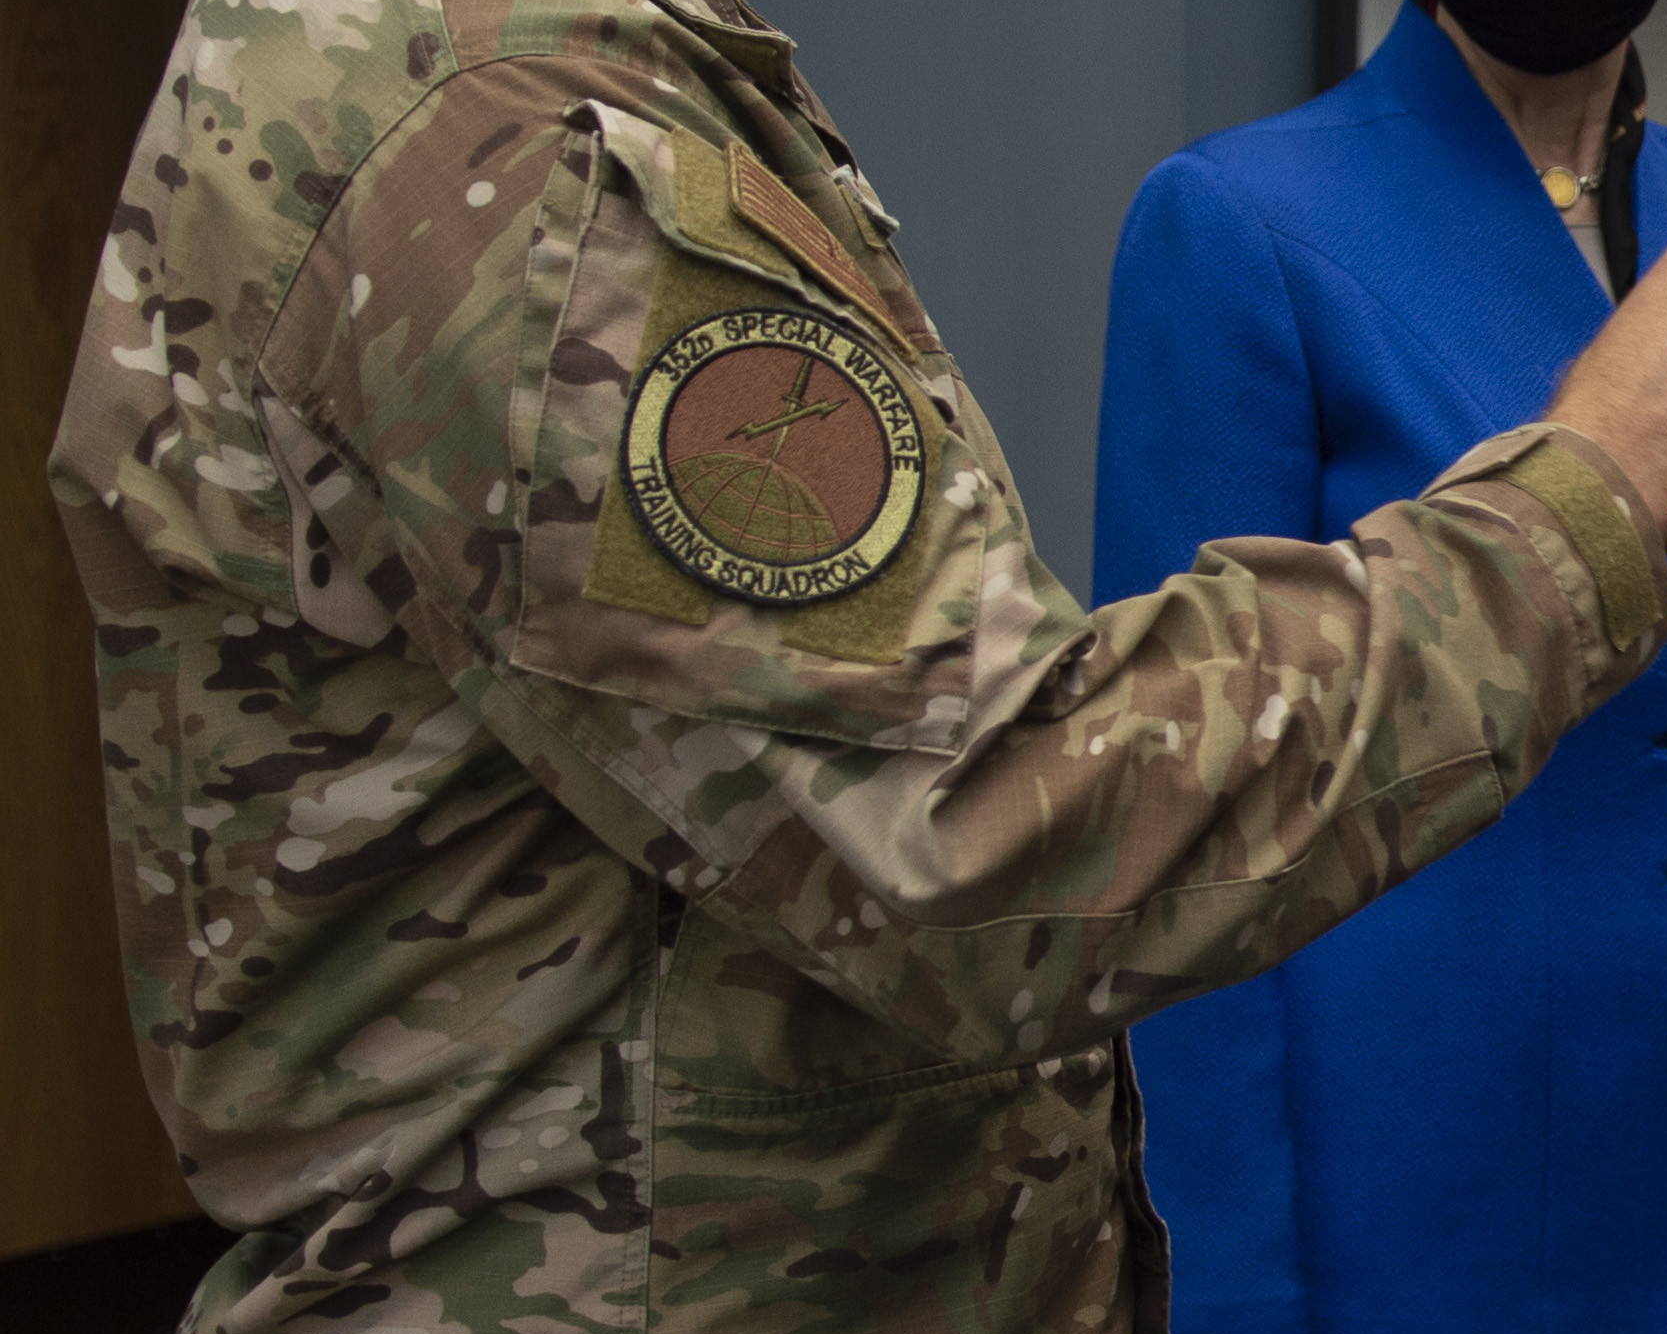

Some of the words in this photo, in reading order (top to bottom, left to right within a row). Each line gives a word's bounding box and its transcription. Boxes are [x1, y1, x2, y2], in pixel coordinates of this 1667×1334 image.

[722, 315, 836, 356] SPECIAL
[844, 345, 922, 475] WARFARE
[631, 455, 718, 569] TRAINING
[717, 550, 872, 598] SQUADRON
